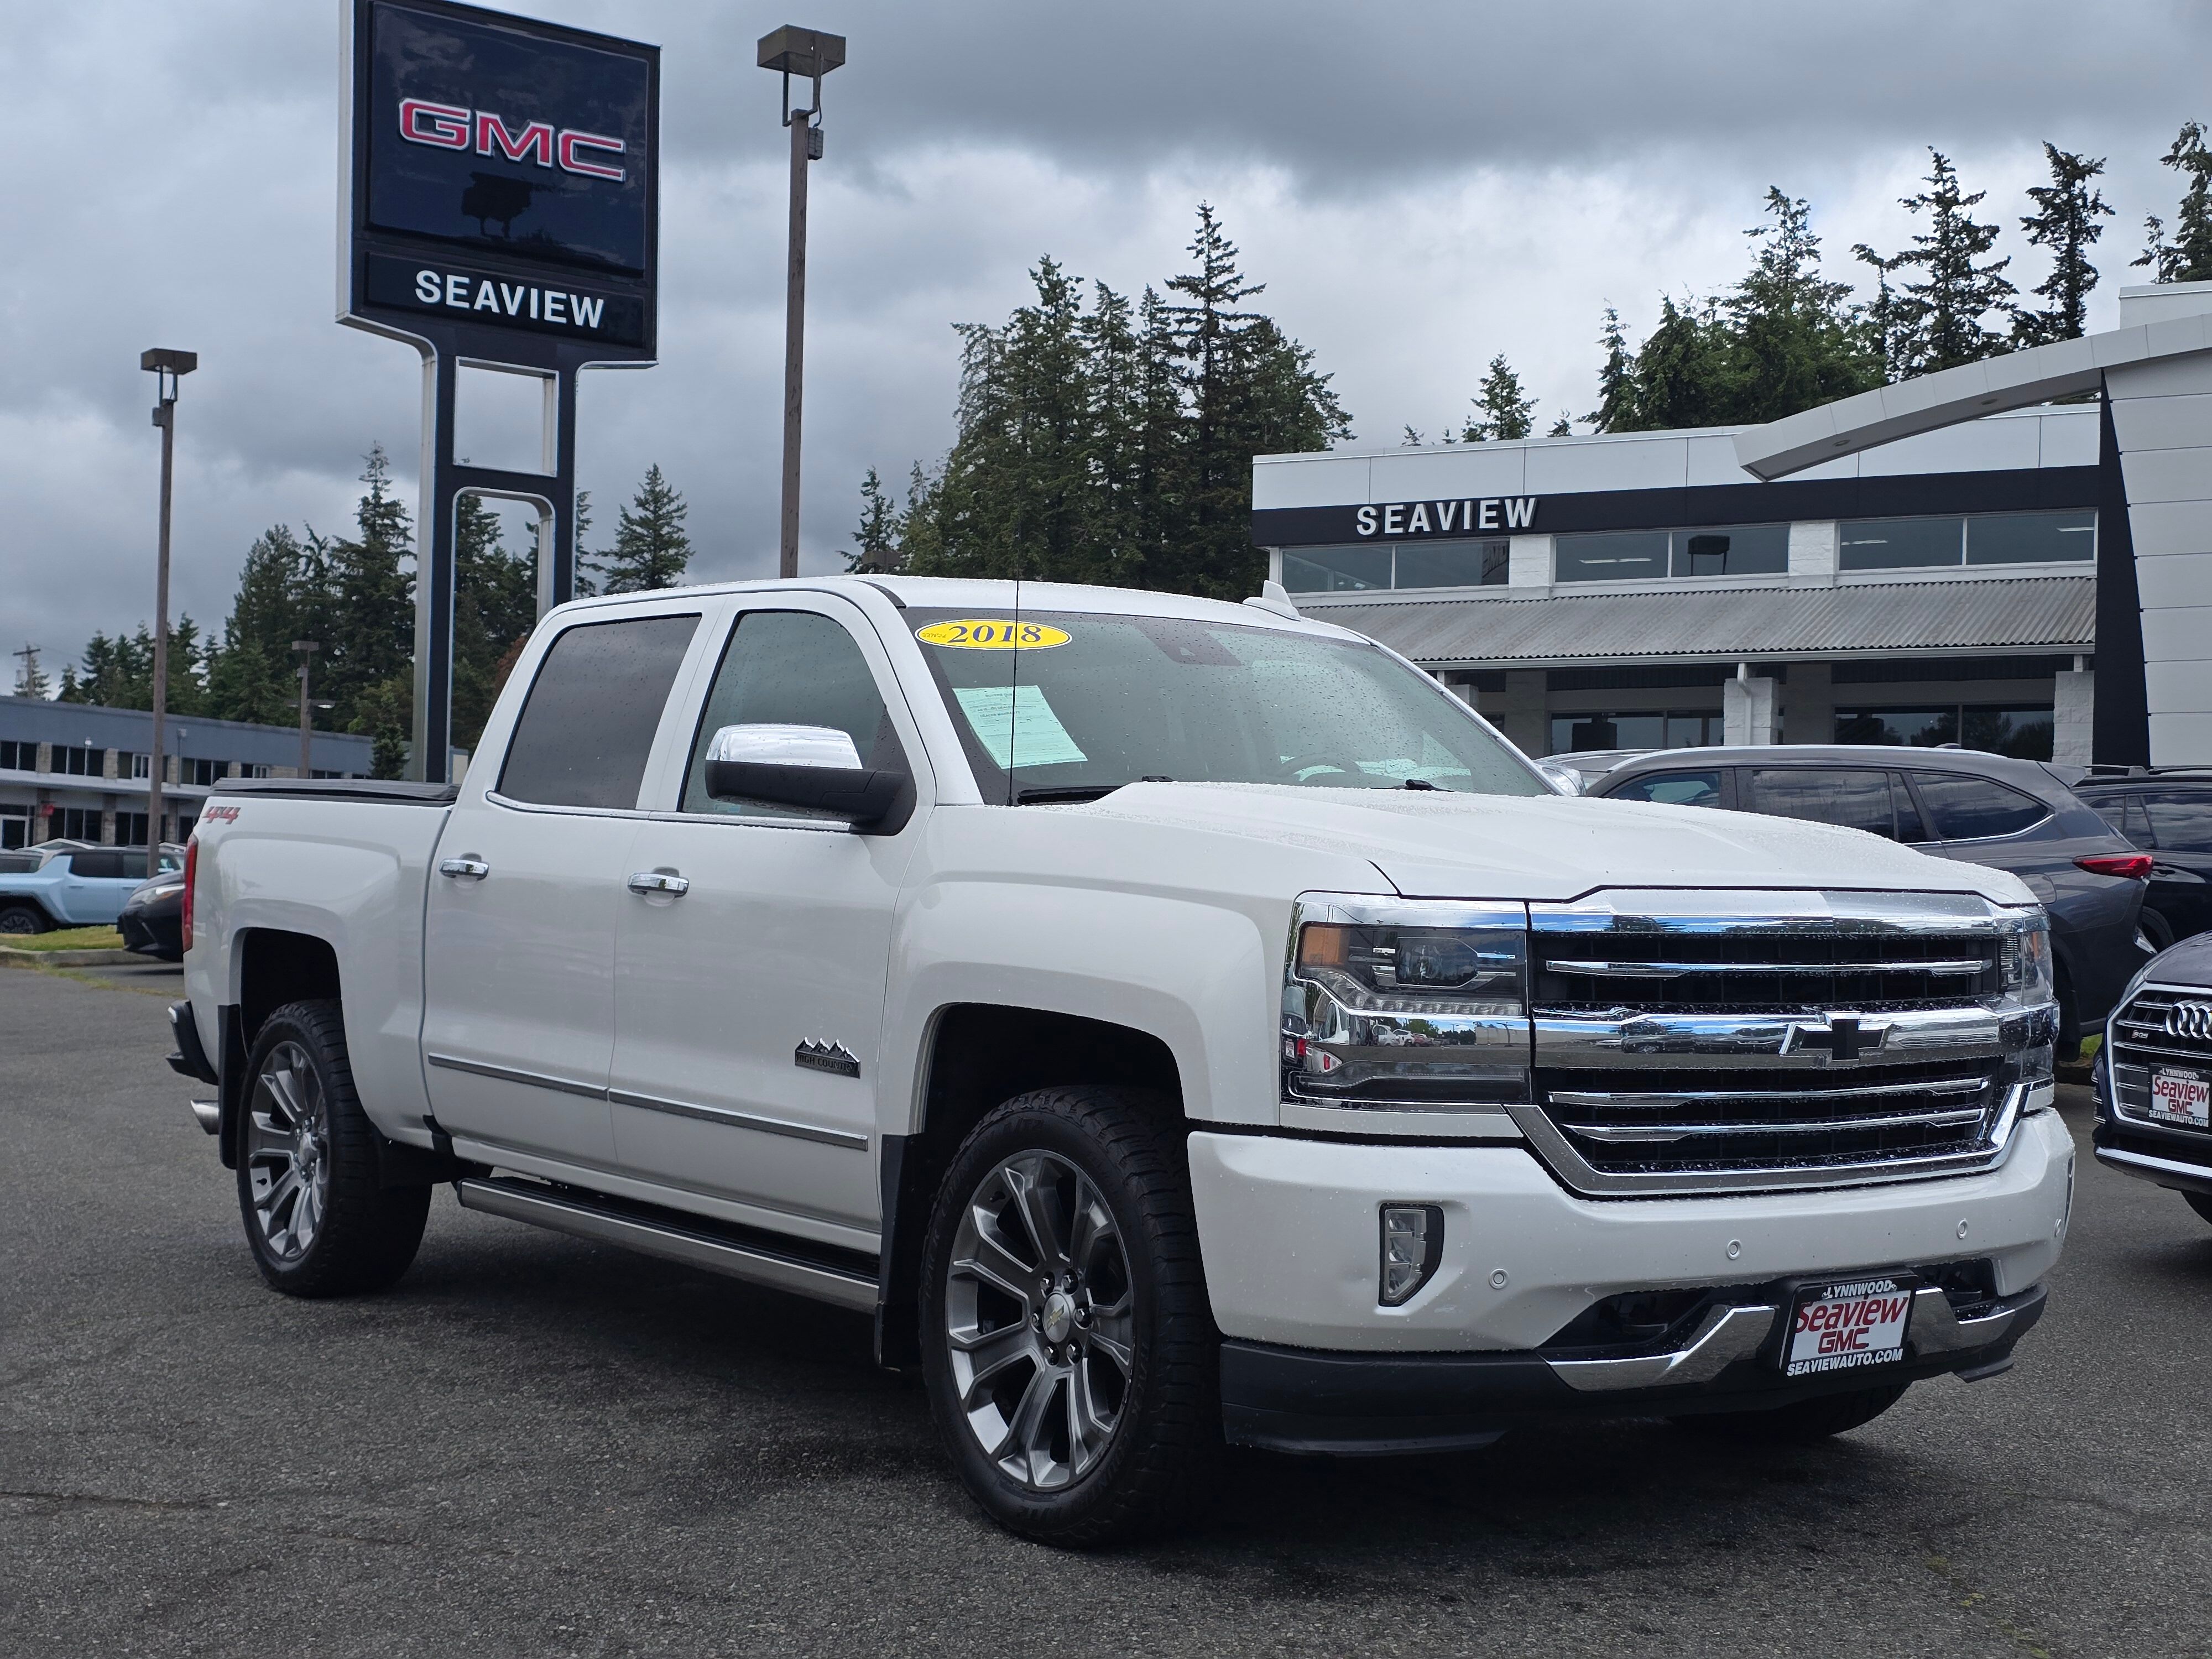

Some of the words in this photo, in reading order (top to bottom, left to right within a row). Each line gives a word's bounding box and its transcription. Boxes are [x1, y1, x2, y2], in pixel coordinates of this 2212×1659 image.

[399, 97, 626, 182] GMC
[415, 270, 604, 328] SEAVIEW
[1357, 498, 1538, 536] SEAVIEW
[947, 625, 1041, 643] 2018
[796, 1054, 815, 1065] HIGH
[2162, 1068, 2198, 1080] LYNNWOOD
[2153, 1076, 2209, 1103] Seaview
[2148, 1109, 2209, 1127] SEAVIEWAUTO.COM
[2168, 1098, 2194, 1115] GMC
[1827, 1280, 1893, 1299] LYNNWOOD
[1796, 1296, 1908, 1333] Seaview
[1818, 1327, 1869, 1354] GMC
[1787, 1348, 1903, 1376] SEAVIEWAUTO.COM
